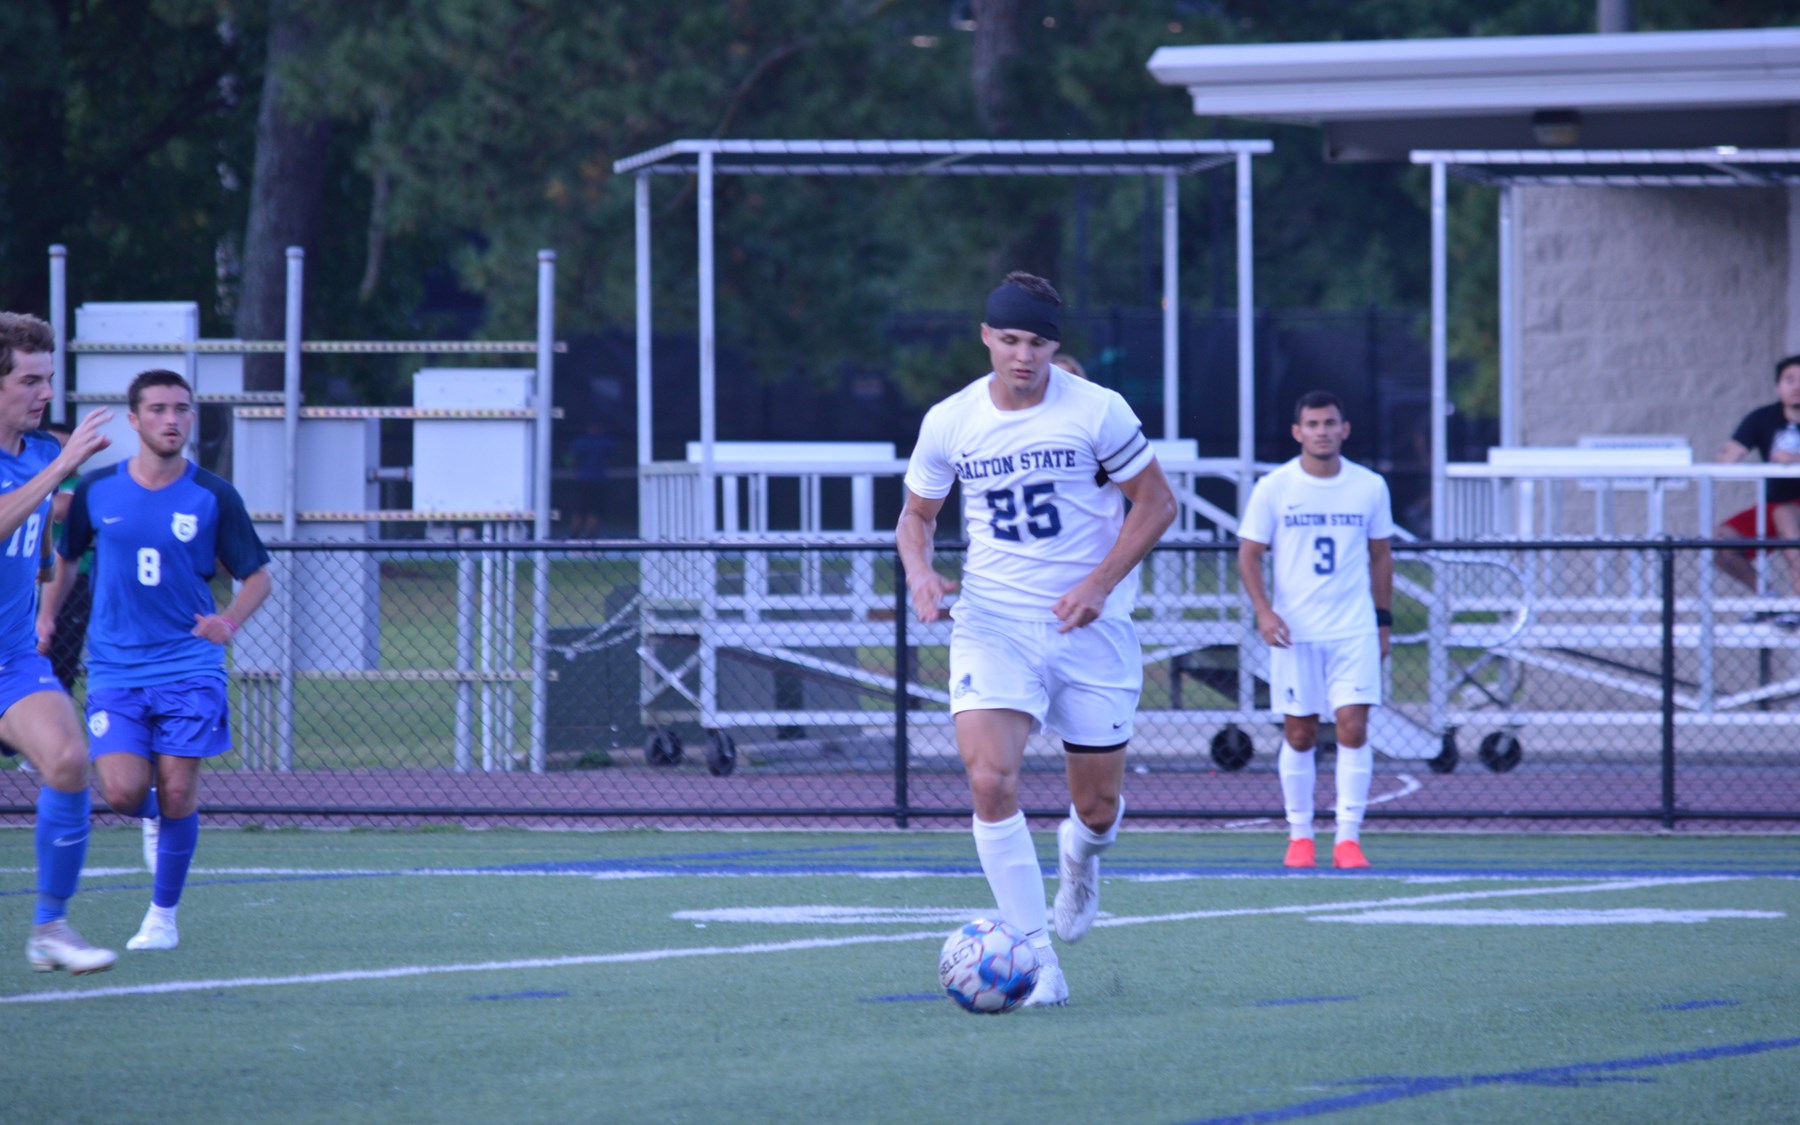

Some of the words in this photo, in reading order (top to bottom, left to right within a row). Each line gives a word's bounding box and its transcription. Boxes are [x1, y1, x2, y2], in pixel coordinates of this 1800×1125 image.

[1020, 450, 1076, 470] STATE
[986, 482, 1062, 542] 25
[1284, 513, 1326, 527] DALTON
[1330, 513, 1364, 527] STATE
[137, 547, 160, 587] 8
[1314, 536, 1335, 575] 3
[940, 942, 976, 975] SELECT
